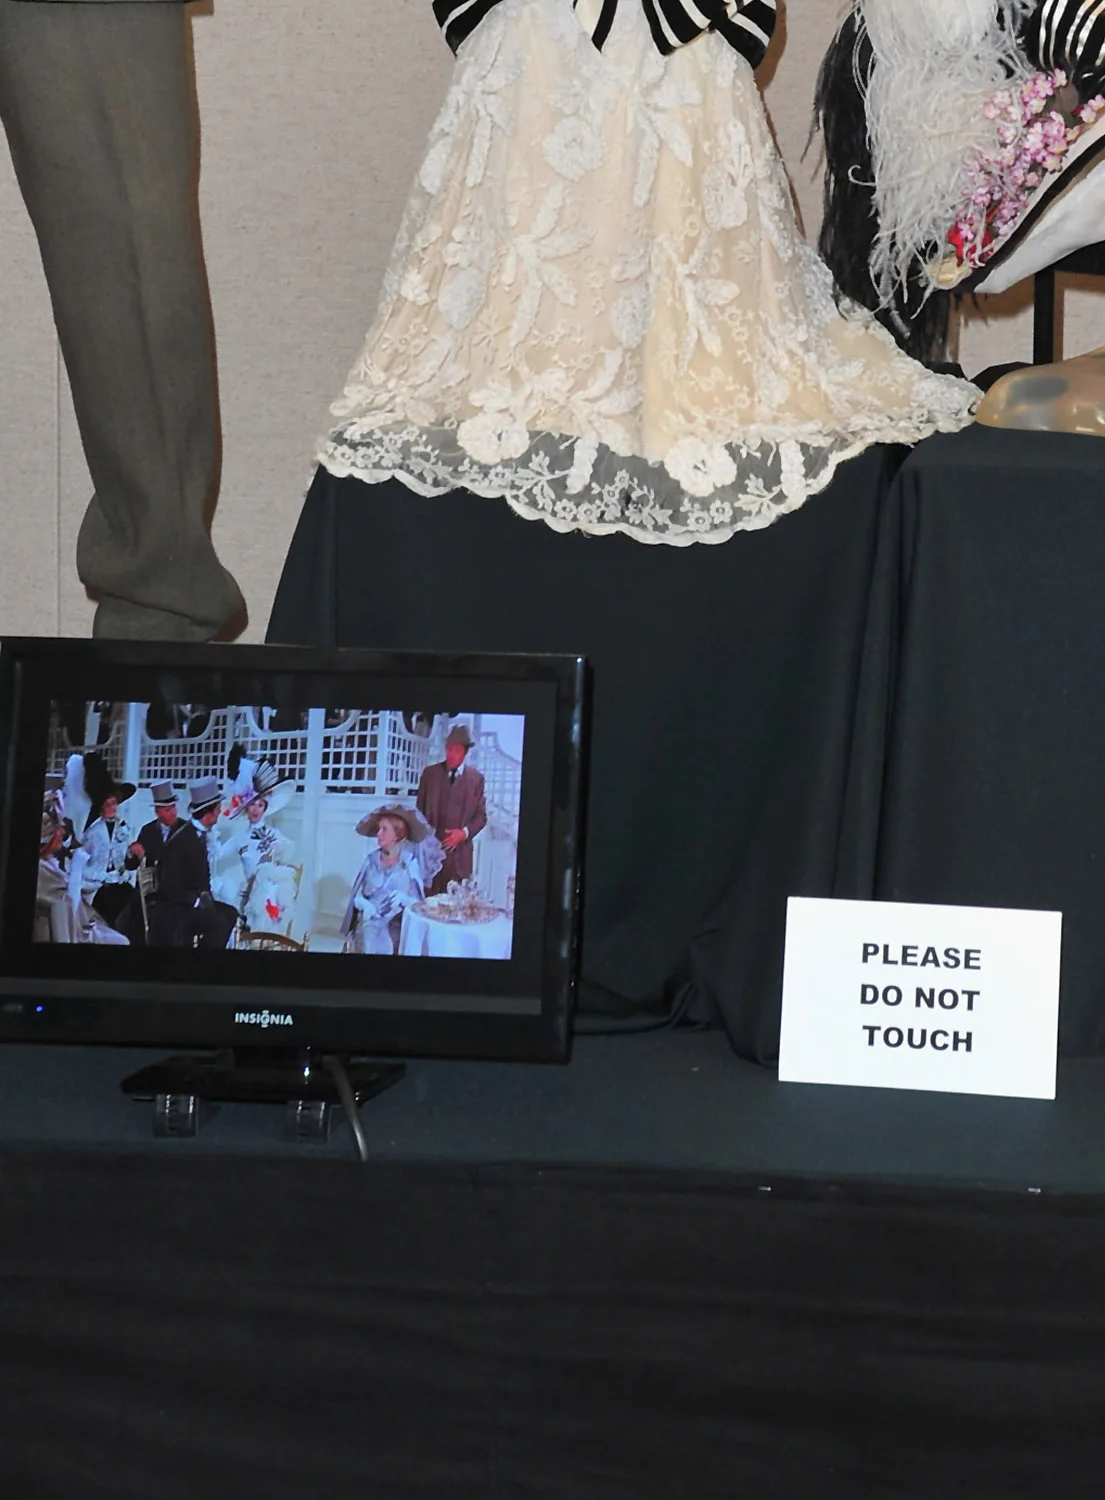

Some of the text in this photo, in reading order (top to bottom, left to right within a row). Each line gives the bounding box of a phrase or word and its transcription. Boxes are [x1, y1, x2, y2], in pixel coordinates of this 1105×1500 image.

[862, 943, 981, 970] PLEASE
[860, 984, 980, 1011] DO NOT
[235, 1010, 293, 1028] INSIGNIA
[862, 1025, 972, 1052] TOUCH
